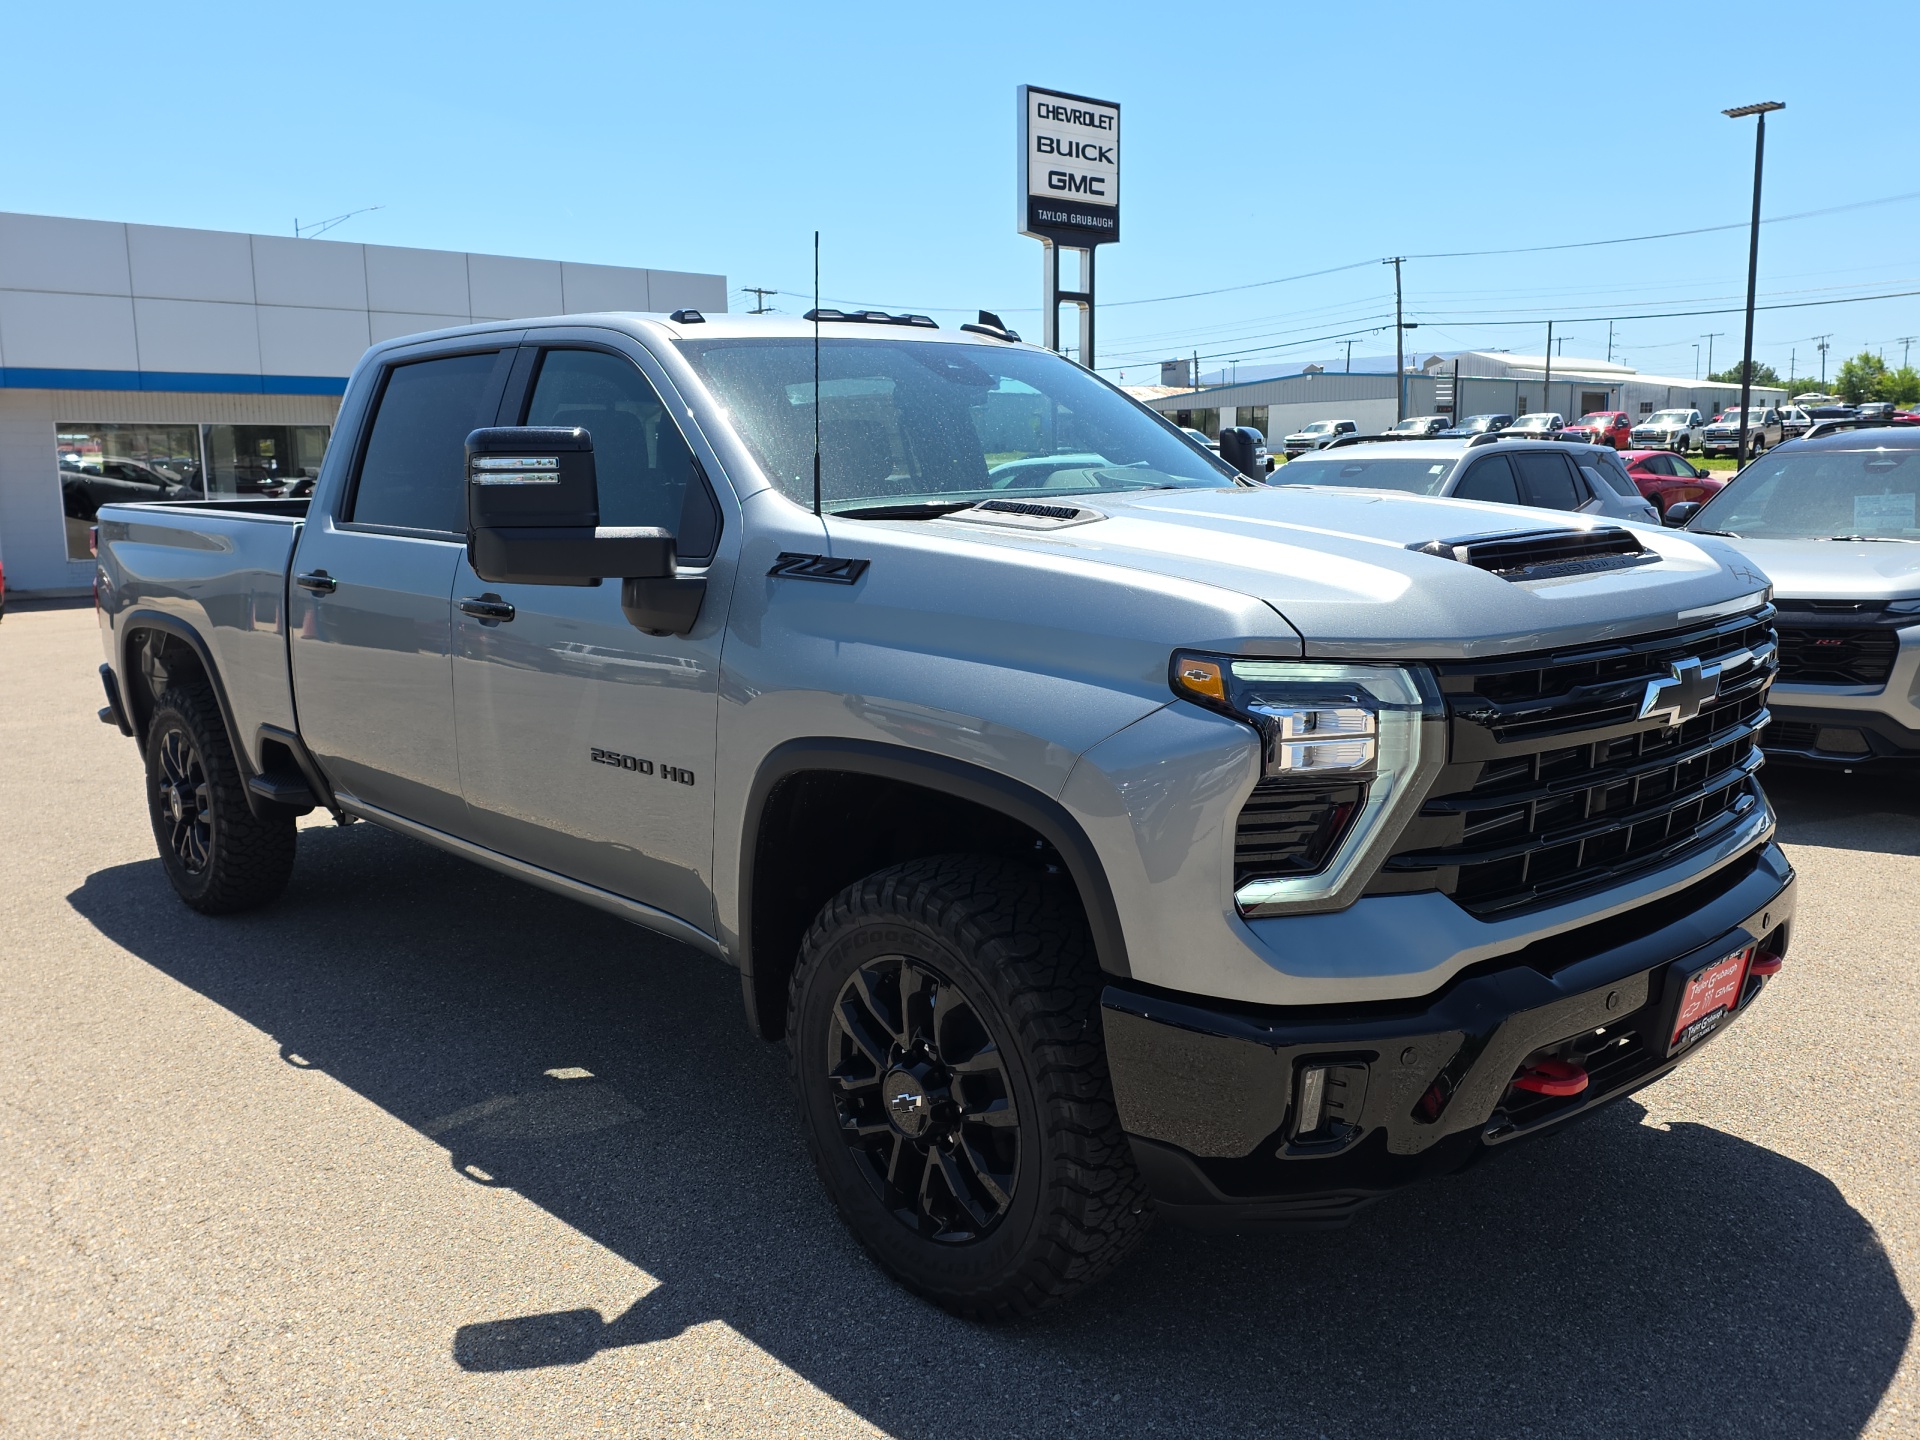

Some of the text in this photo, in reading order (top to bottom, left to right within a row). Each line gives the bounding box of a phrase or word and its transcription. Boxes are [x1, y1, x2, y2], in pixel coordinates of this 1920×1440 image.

[1037, 102, 1114, 131] CHEVROLET
[1036, 135, 1115, 165] BUICK
[1048, 170, 1105, 196] GMC
[1038, 209, 1114, 228] TAYLOR GRUBAUGH
[590, 747, 695, 786] 2500 HD
[1690, 962, 1738, 1000] Taylor Grubaugh
[1715, 981, 1736, 998] GMC
